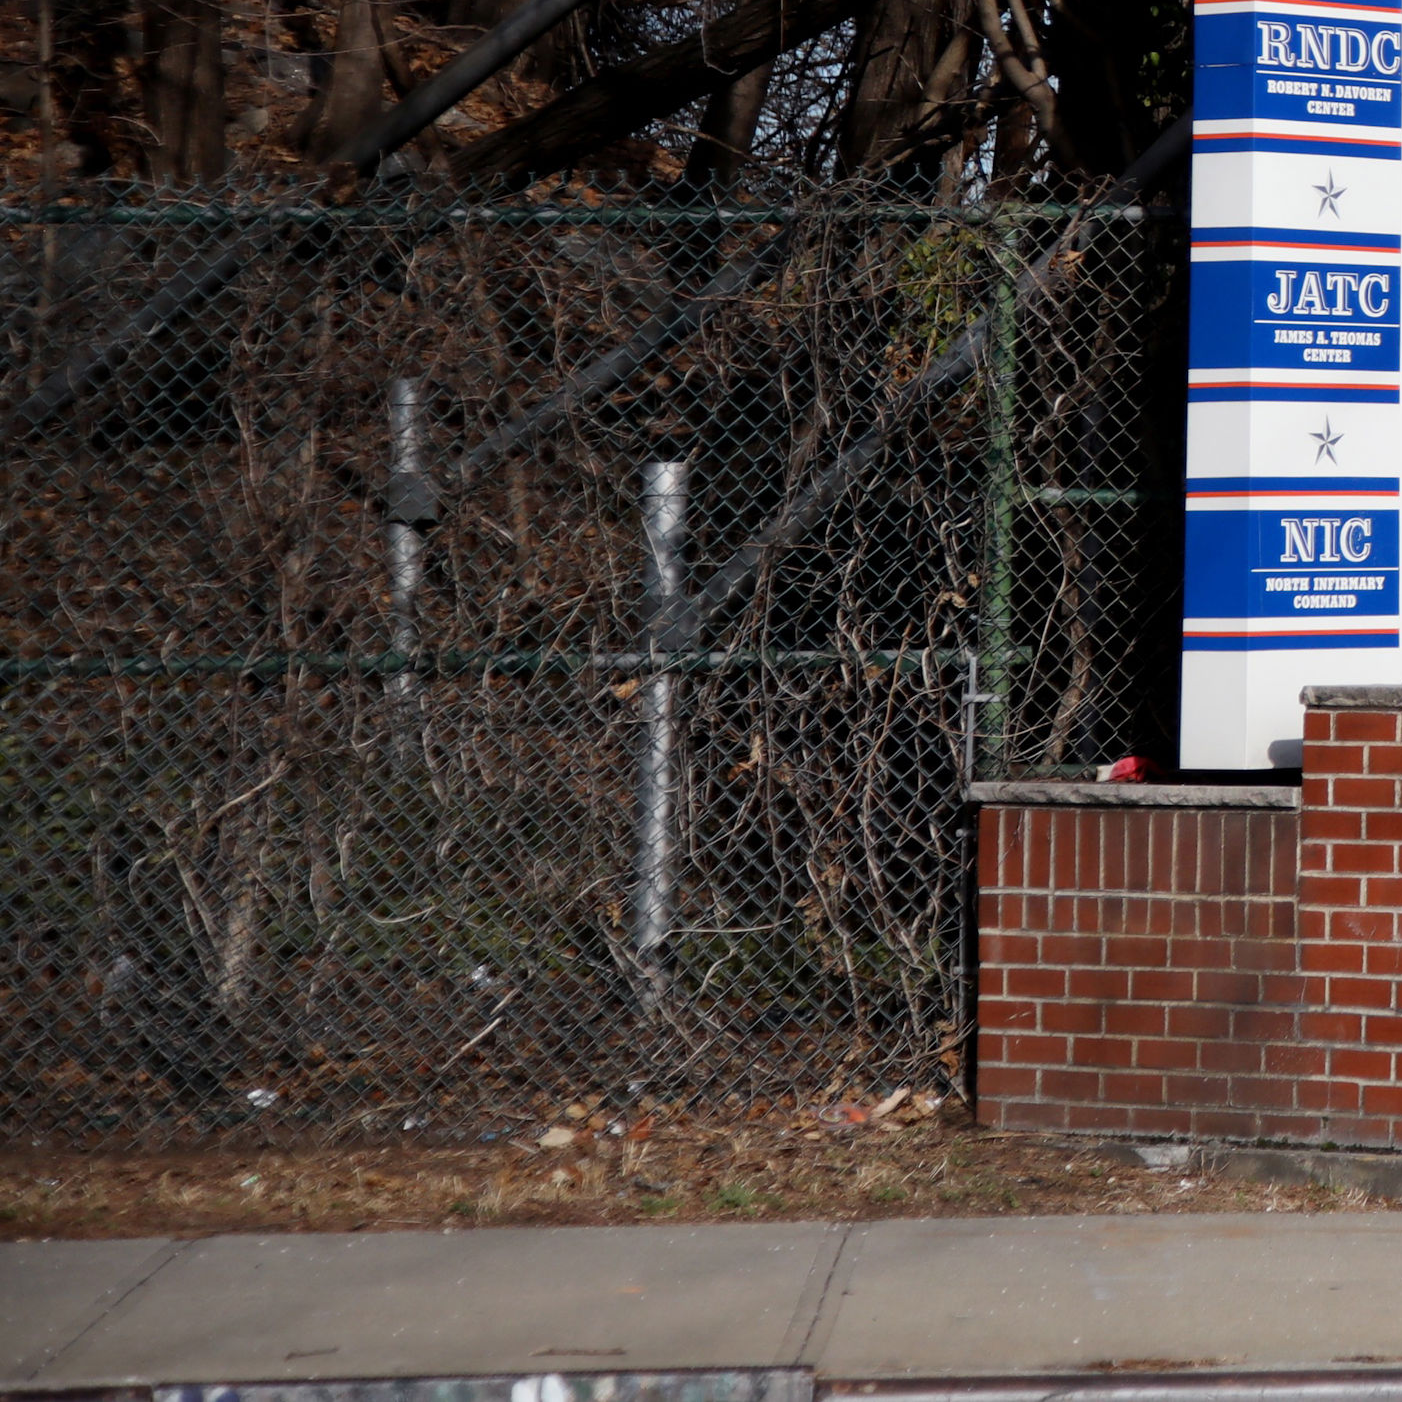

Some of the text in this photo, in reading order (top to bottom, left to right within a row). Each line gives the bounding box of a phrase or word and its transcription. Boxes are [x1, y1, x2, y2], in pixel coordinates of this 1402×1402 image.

[1257, 20, 1401, 75] RNDC
[1267, 79, 1392, 102] ROBERT N. DAVOREN
[1306, 100, 1355, 117] CENTER
[1267, 269, 1390, 318] JATC
[1274, 329, 1382, 346] JAMES A. THOMAS
[1303, 348, 1352, 363] CENTER
[1280, 517, 1372, 563] NIC
[1265, 576, 1386, 592] NORTH INFIRMARY
[1293, 594, 1357, 609] COMMAND
